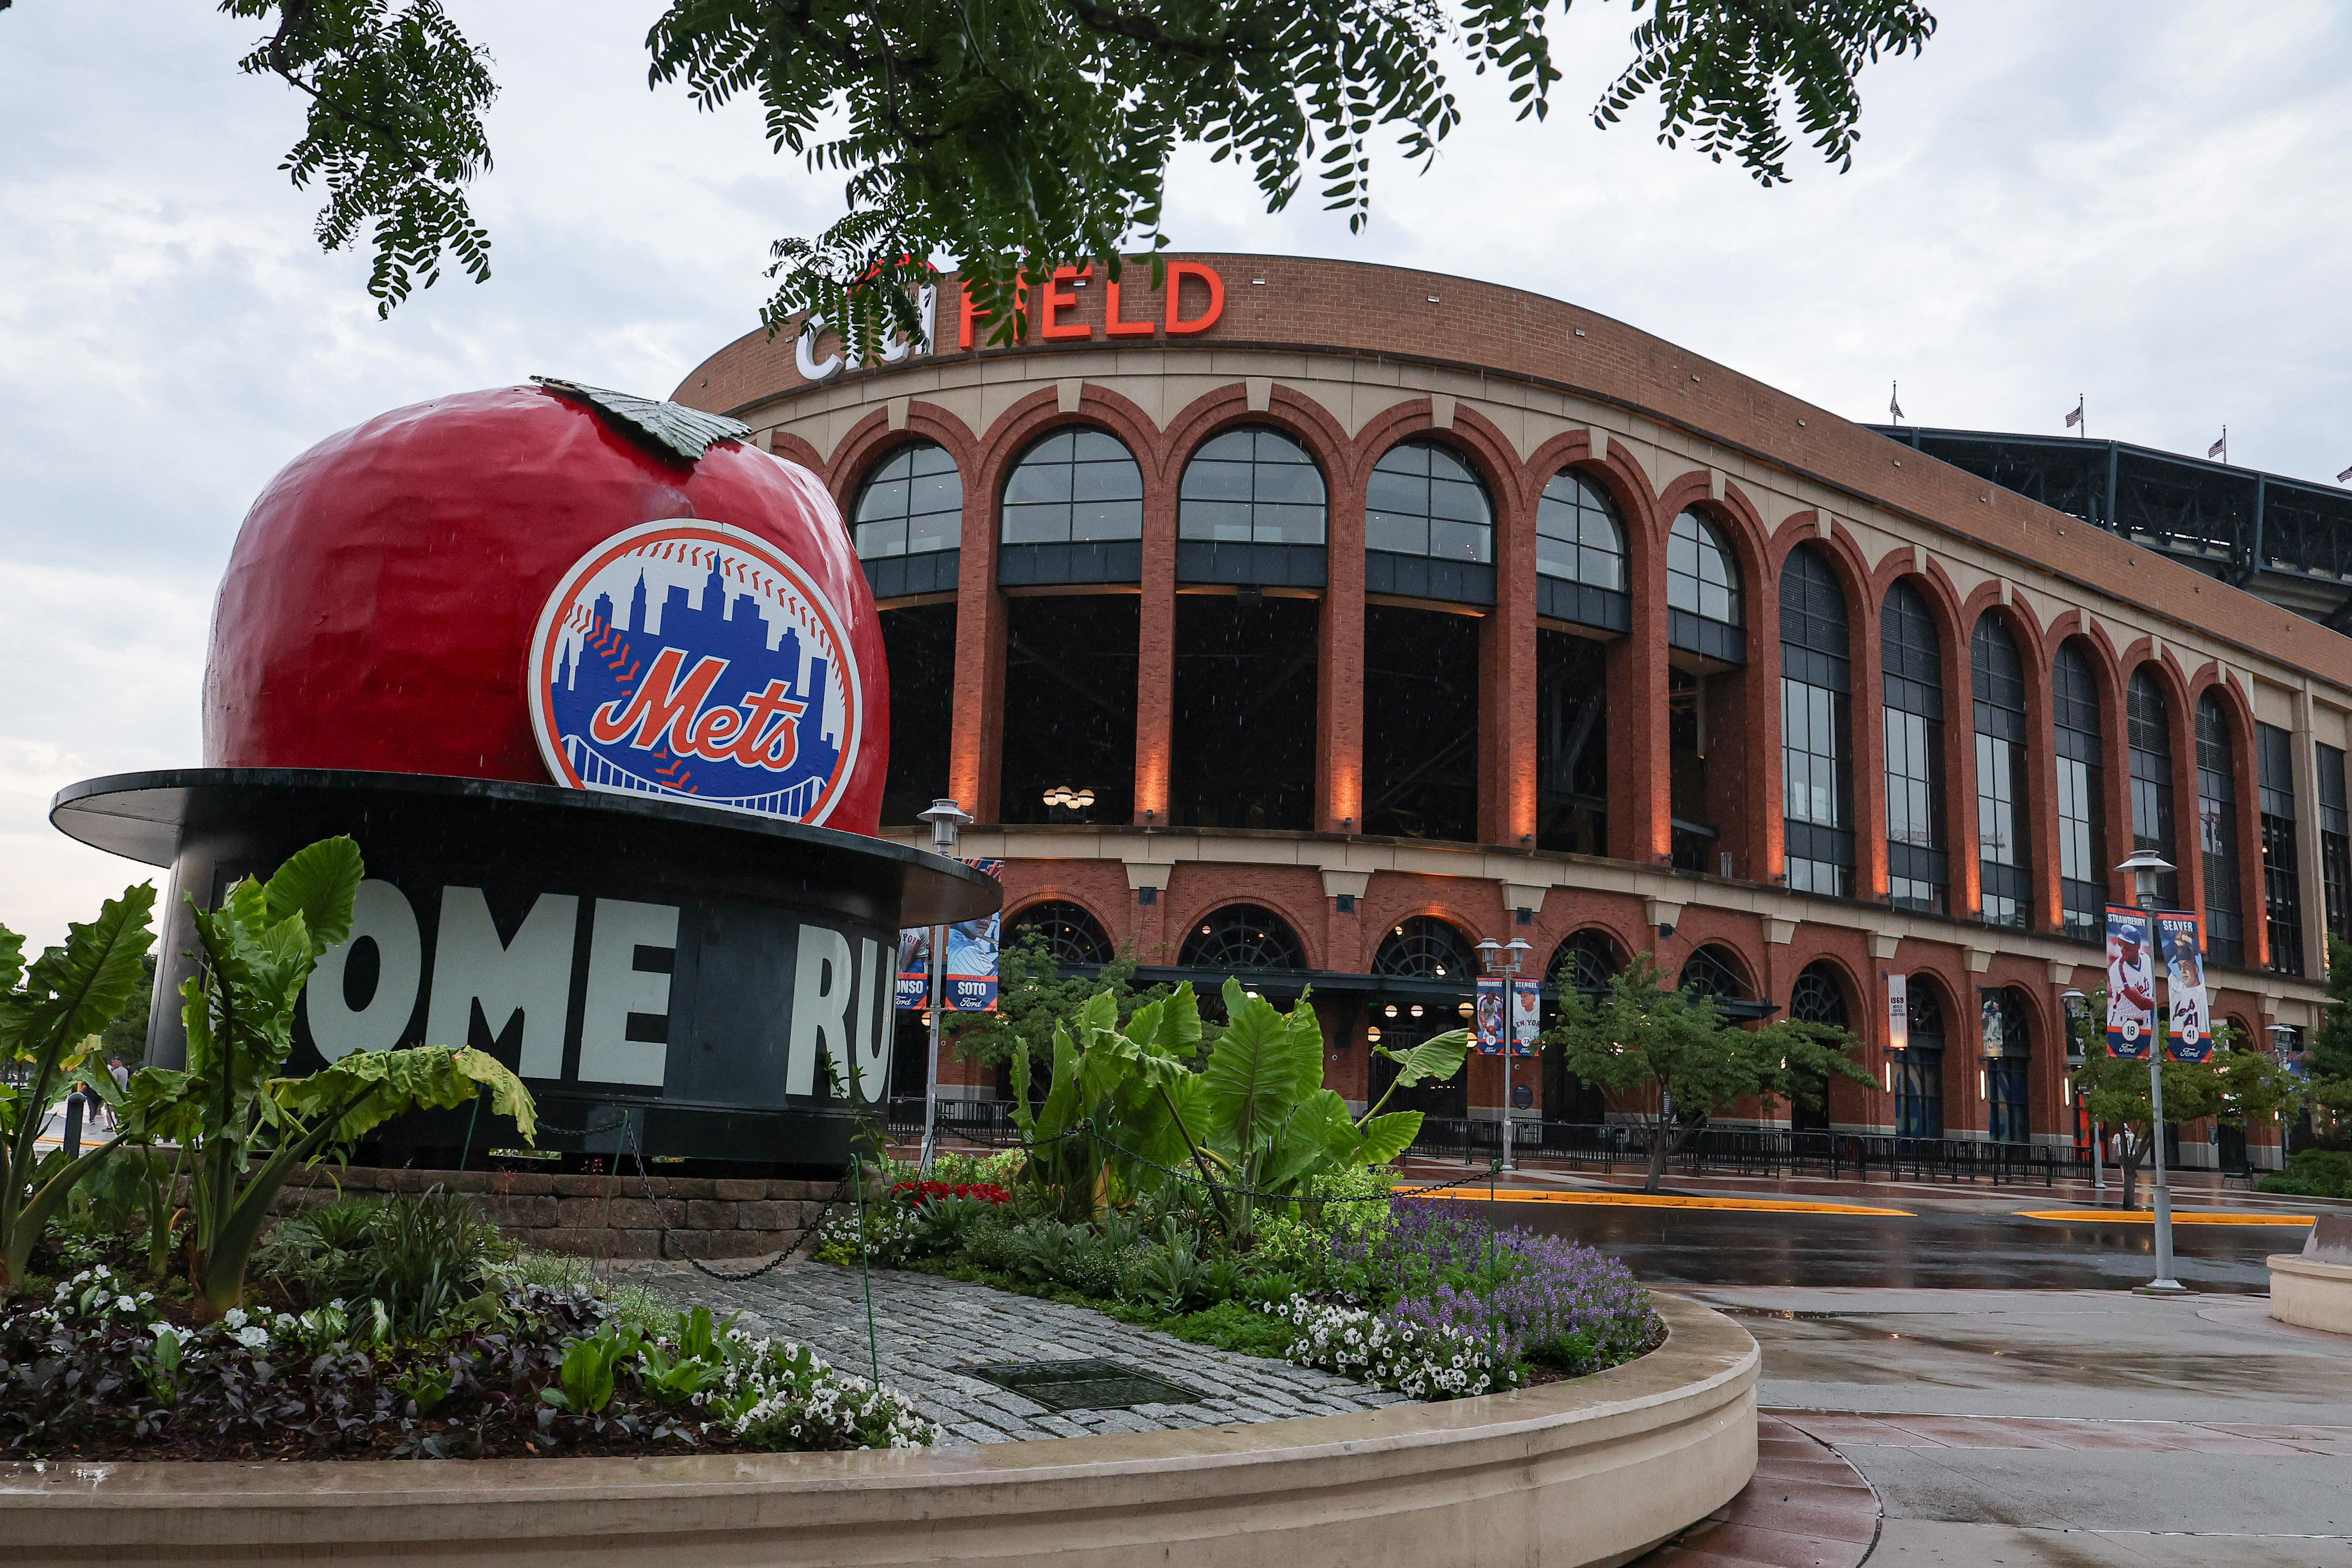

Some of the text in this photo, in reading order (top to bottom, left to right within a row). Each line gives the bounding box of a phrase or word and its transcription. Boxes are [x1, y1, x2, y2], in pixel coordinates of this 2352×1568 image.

[953, 261, 1225, 351] FIELD
[589, 645, 809, 773] Mets
[2108, 913, 2146, 927] STRAWBERRY
[2162, 920, 2193, 932] SEAVER
[212, 879, 895, 1104] OME RU
[958, 981, 986, 995] SOTO
[960, 997, 982, 1007] Ford
[2127, 1026, 2135, 1036] 18
[2186, 1029, 2195, 1040] 41
[2119, 1043, 2137, 1054] Ford
[2180, 1047, 2200, 1057] Ford
